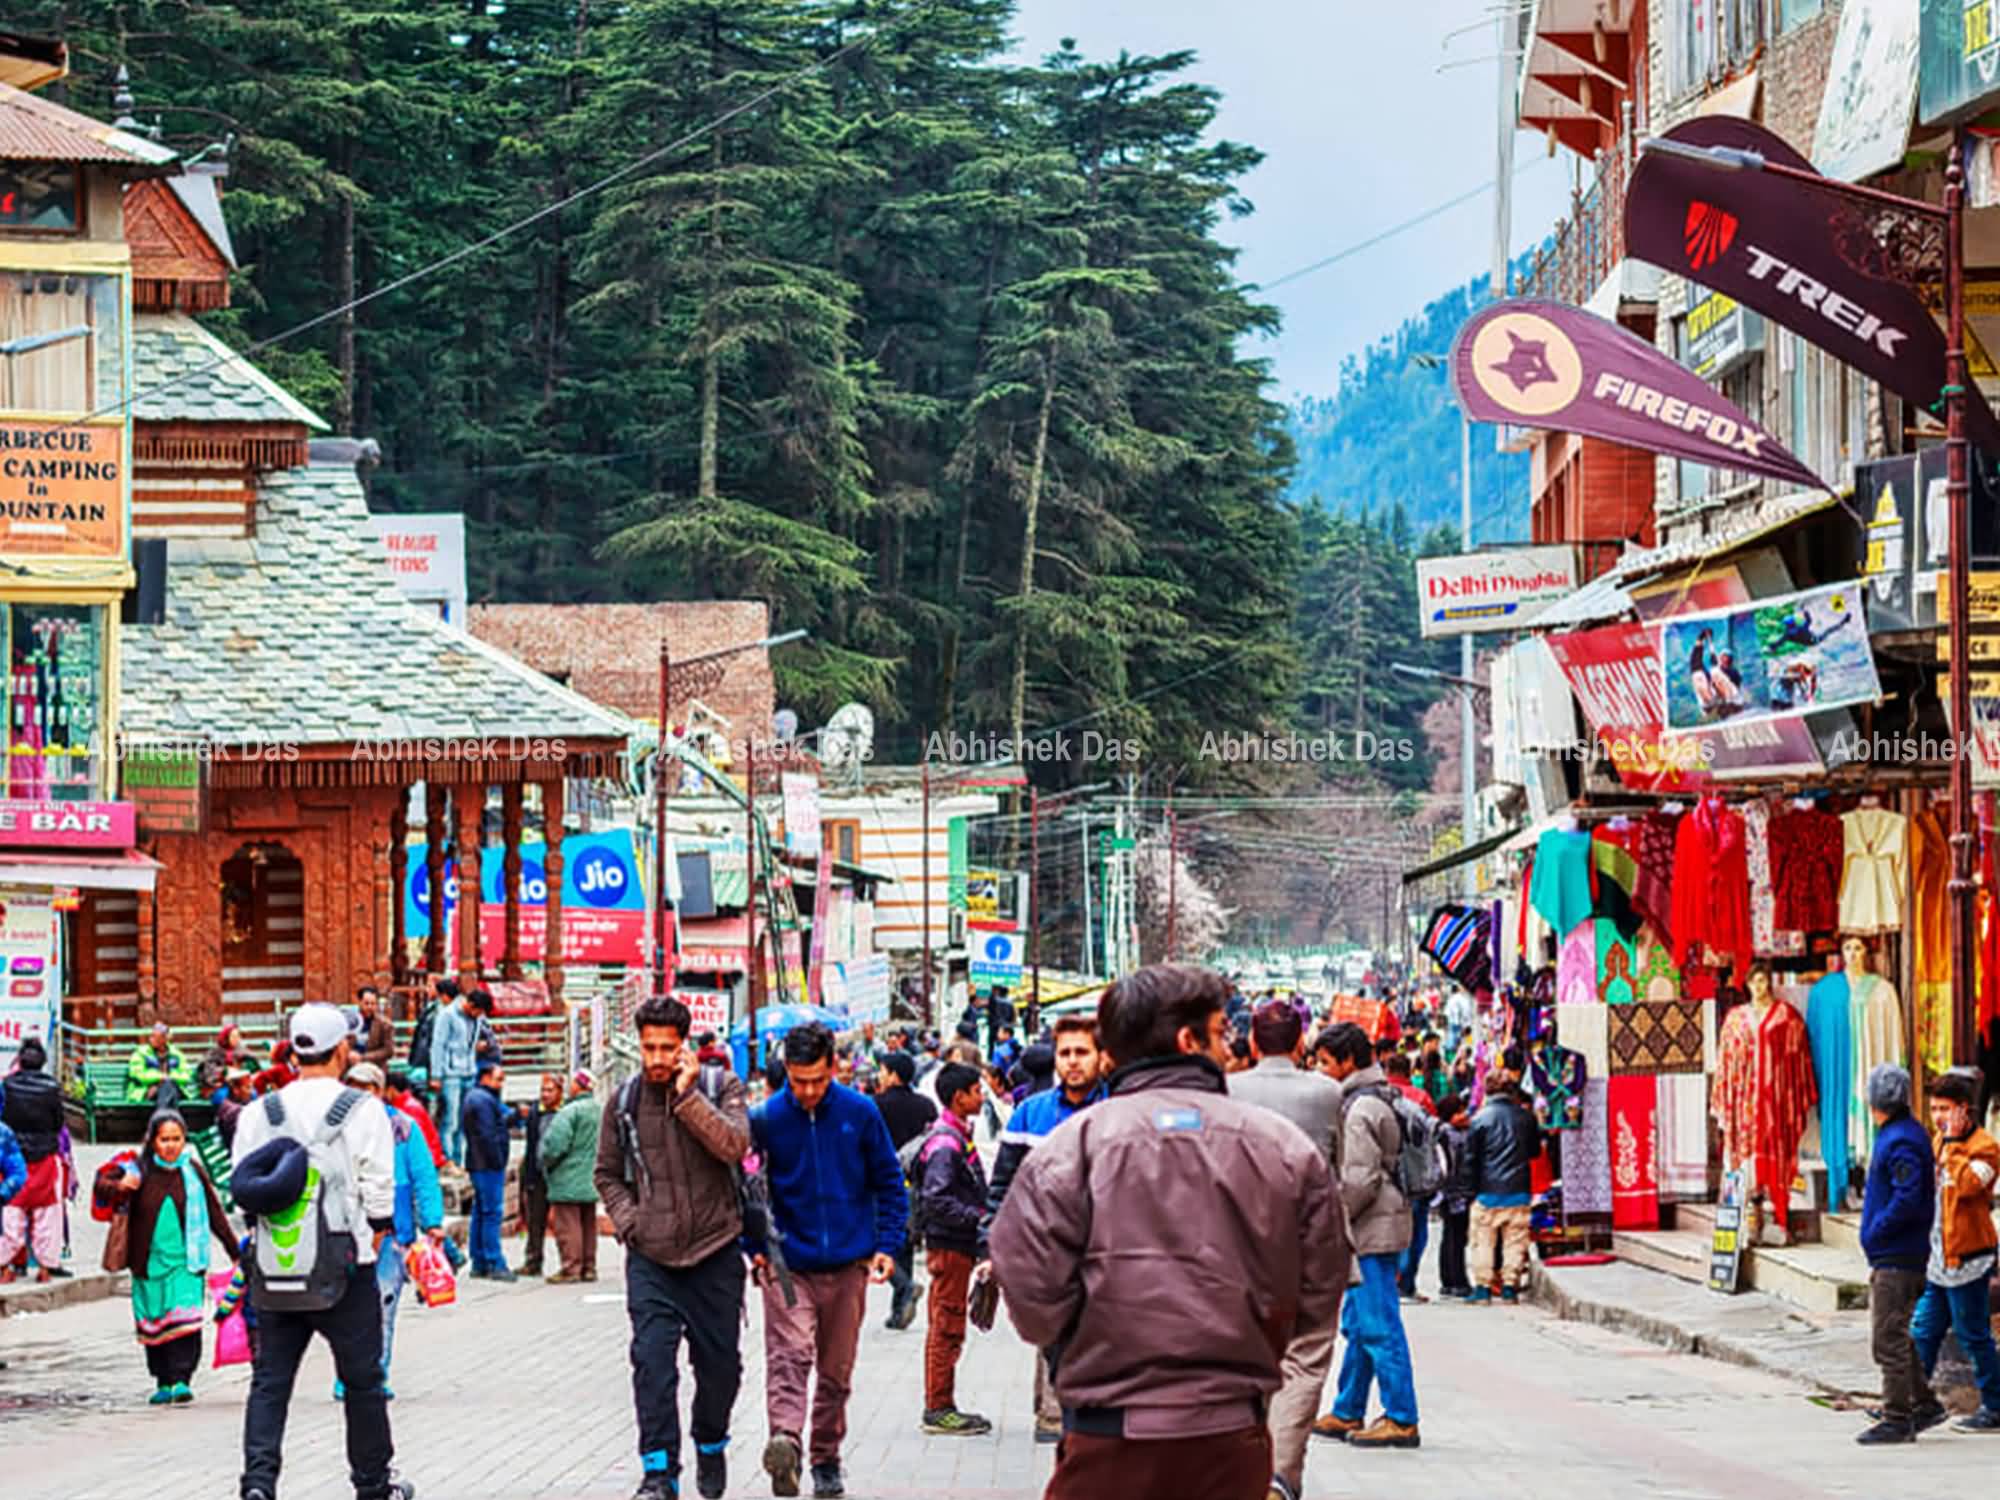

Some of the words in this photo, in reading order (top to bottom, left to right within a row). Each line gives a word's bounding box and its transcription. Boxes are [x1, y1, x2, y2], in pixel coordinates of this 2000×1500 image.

[1747, 245, 1908, 357] TREK
[1593, 372, 1766, 457] FIREFOX
[4, 458, 117, 480] CAMPING
[28, 482, 48, 496] In
[1428, 574, 1488, 599] Delhi
[32, 812, 111, 832] BAR
[418, 866, 461, 904] Jo
[519, 873, 547, 900] io
[580, 860, 624, 892] Jio
